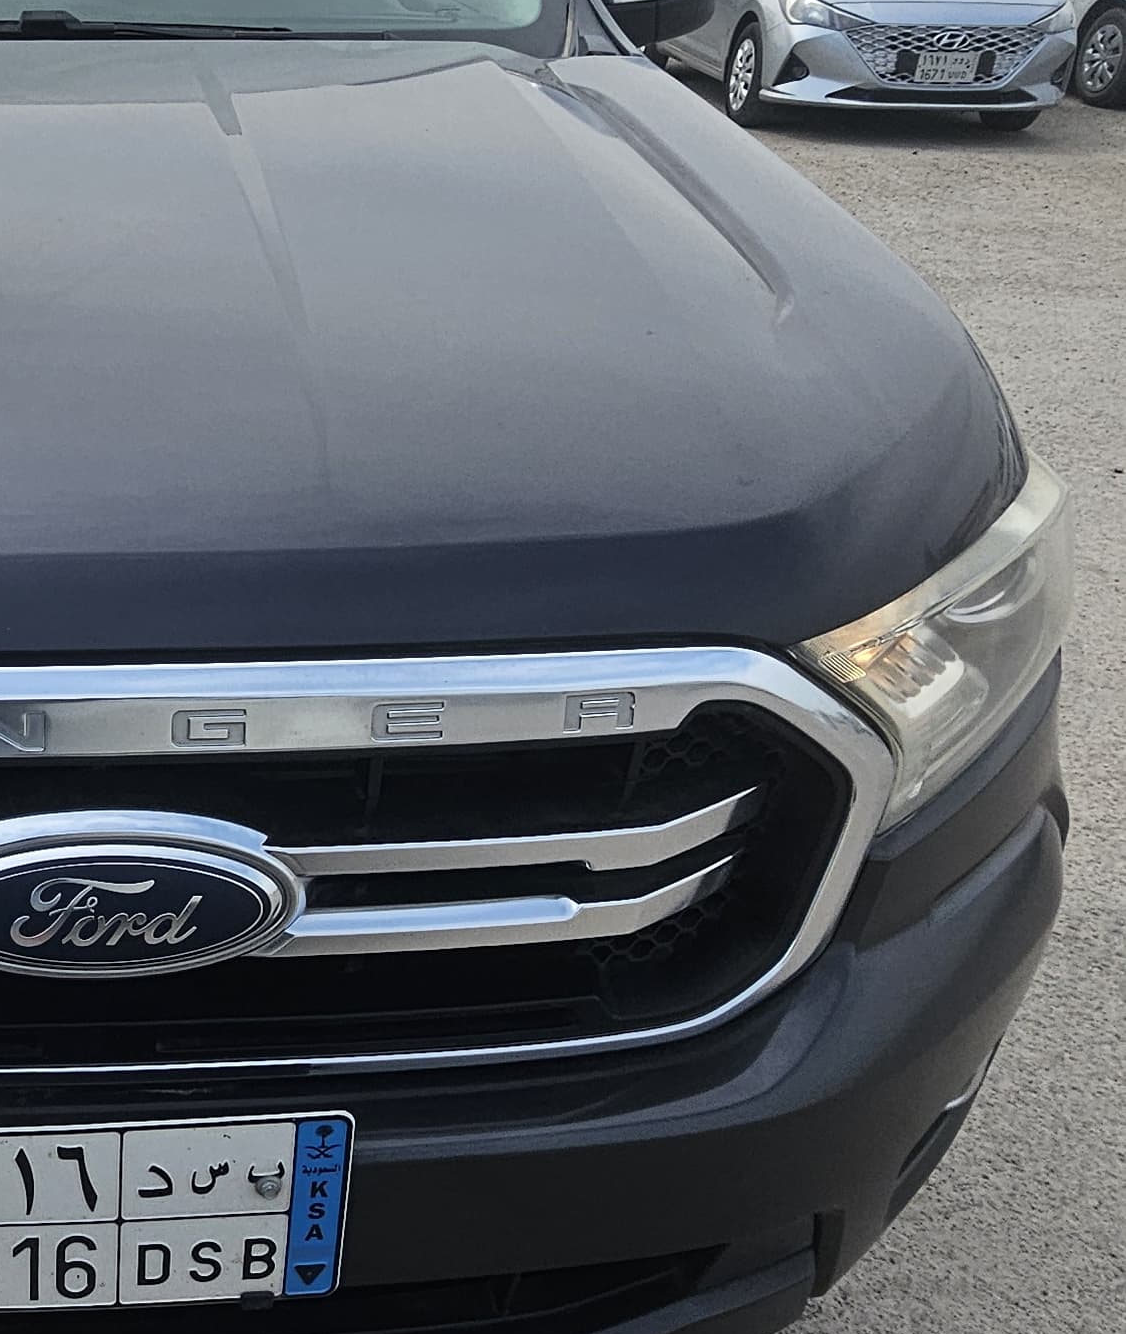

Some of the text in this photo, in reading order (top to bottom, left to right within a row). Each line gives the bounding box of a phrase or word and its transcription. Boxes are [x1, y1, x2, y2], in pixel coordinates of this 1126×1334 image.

[9, 876, 205, 949] Ford
[304, 1180, 330, 1242] KSA
[136, 1238, 278, 1286] DSB
